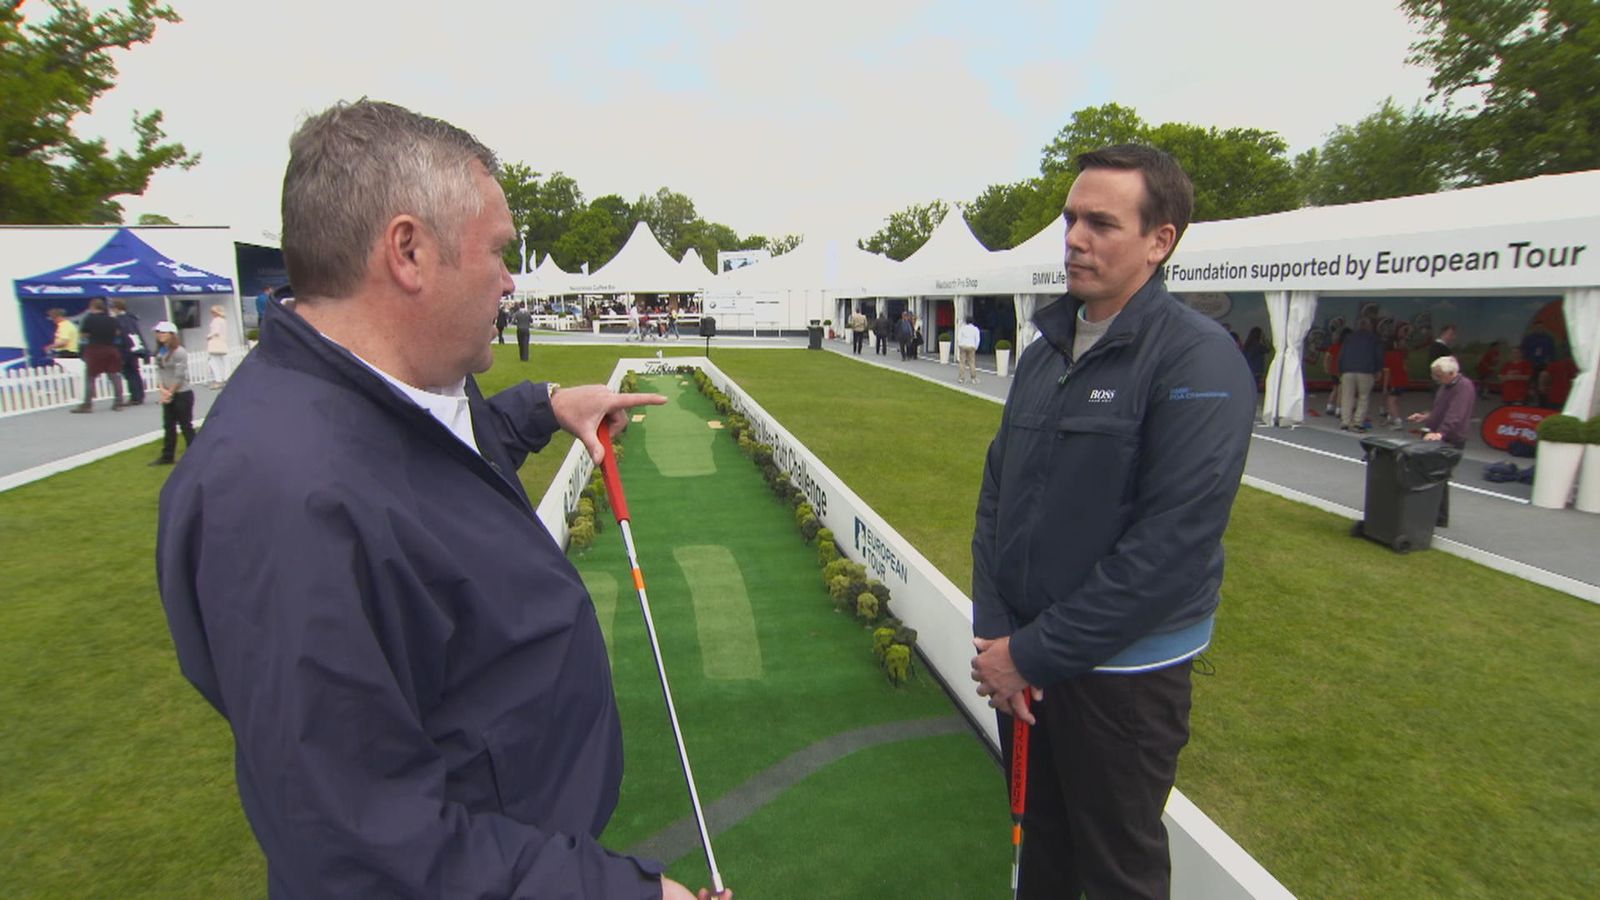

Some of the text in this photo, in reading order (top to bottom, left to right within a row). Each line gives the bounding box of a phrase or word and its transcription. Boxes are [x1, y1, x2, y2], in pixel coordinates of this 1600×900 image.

[1032, 272, 1051, 285] BMW
[1172, 262, 1247, 281] Foundation
[1251, 255, 1341, 282] supported
[1345, 254, 1371, 280] by
[1376, 251, 1499, 277] European
[1508, 241, 1587, 269] Tour
[966, 277, 978, 288] Shop
[1089, 389, 1116, 399] BOSS
[788, 446, 827, 517] Challenge
[867, 528, 908, 585] EUROPEAN
[867, 547, 887, 582] TOUR
